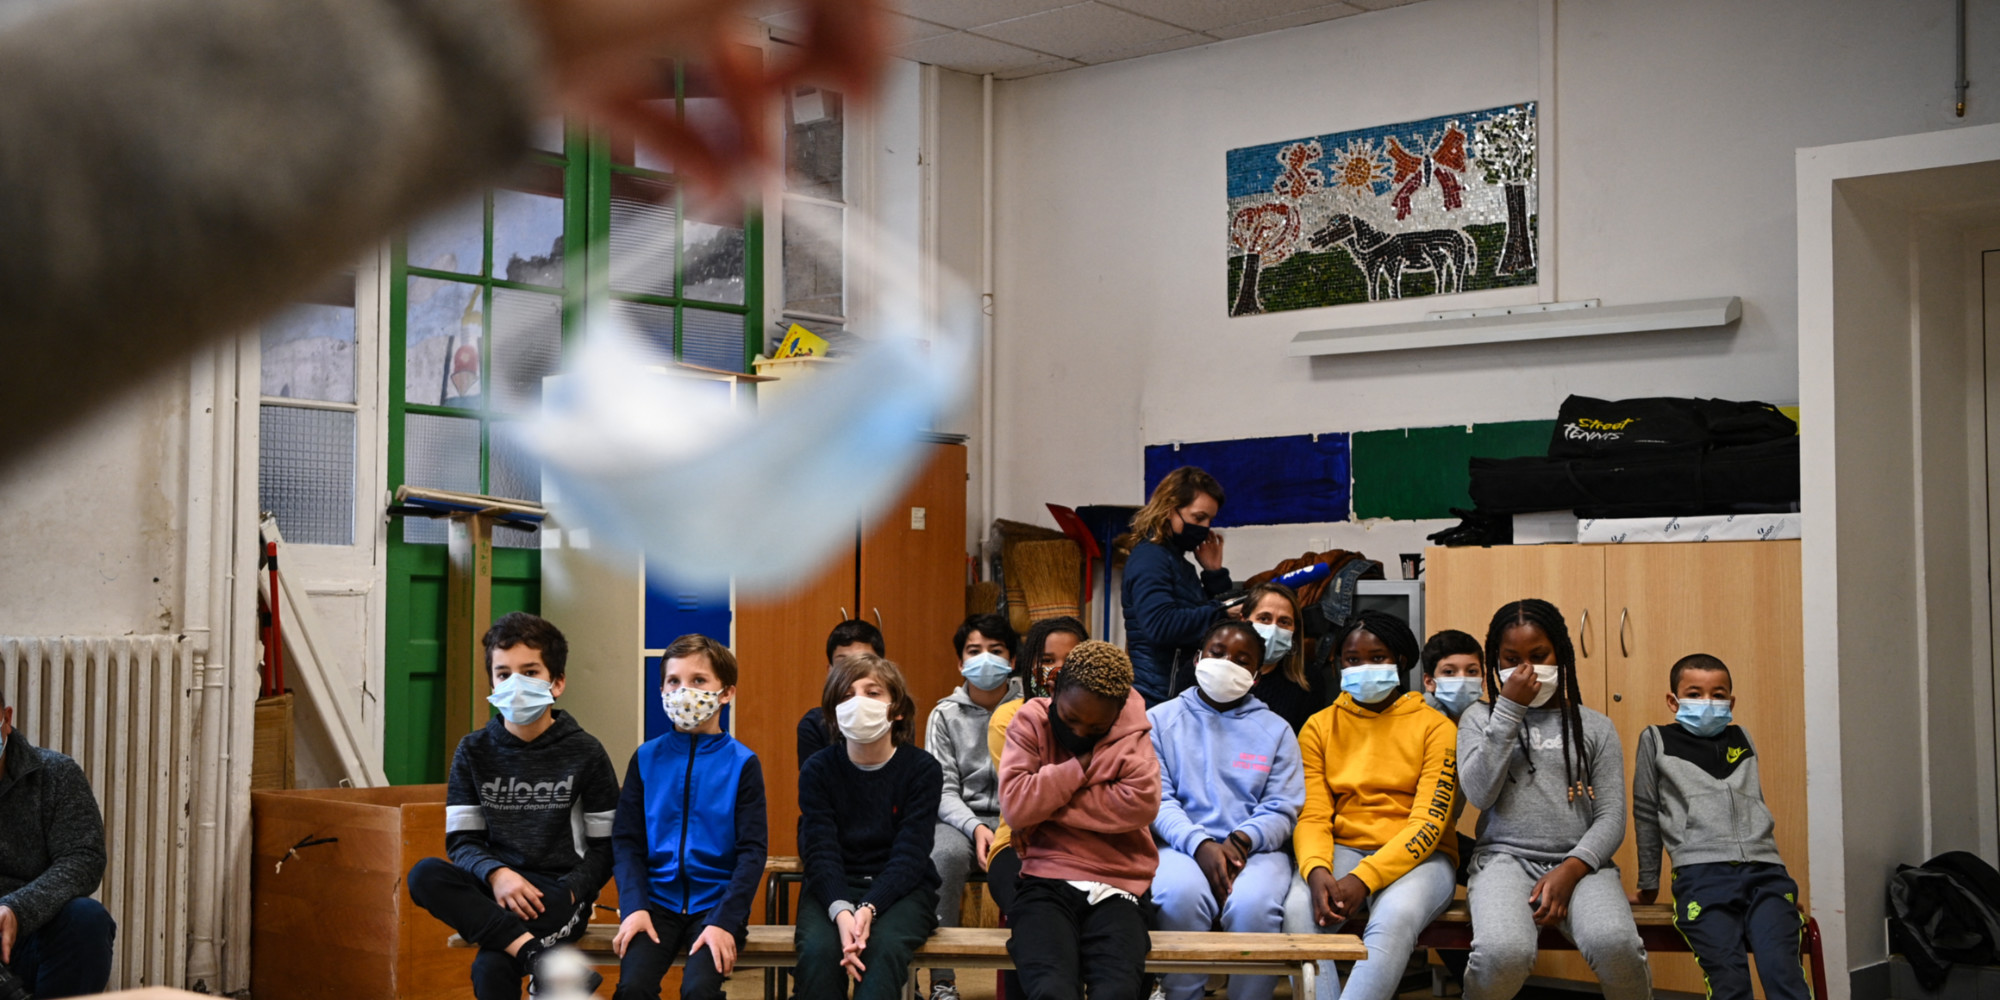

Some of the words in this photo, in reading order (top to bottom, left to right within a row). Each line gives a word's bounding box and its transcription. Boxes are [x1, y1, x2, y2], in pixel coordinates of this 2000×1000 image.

[1579, 418, 1634, 430] Street
[1428, 758, 1457, 822] STRONG
[1405, 822, 1440, 860] GIRLS
